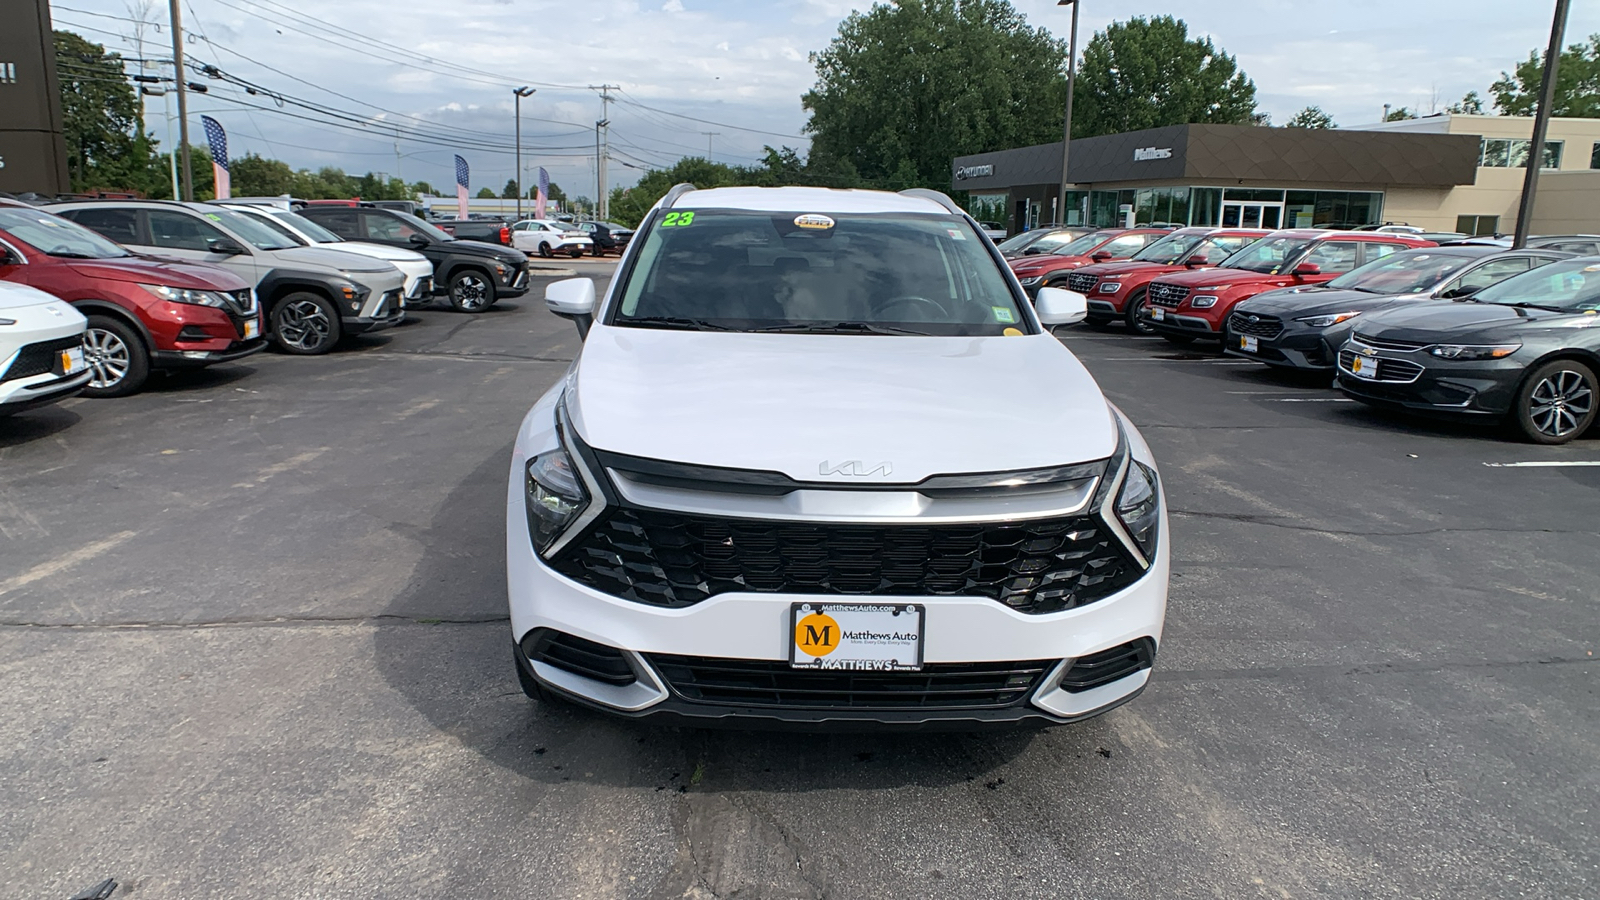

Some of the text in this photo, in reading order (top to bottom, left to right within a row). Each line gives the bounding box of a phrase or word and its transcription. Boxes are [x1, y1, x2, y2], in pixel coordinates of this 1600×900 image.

[1134, 147, 1172, 161] Matthews
[662, 211, 695, 227] 23
[821, 604, 896, 612] MatthewsAuto.com
[802, 624, 833, 647] M
[842, 630, 918, 641] Matthews Auto
[820, 659, 892, 671] MATTHEWS
